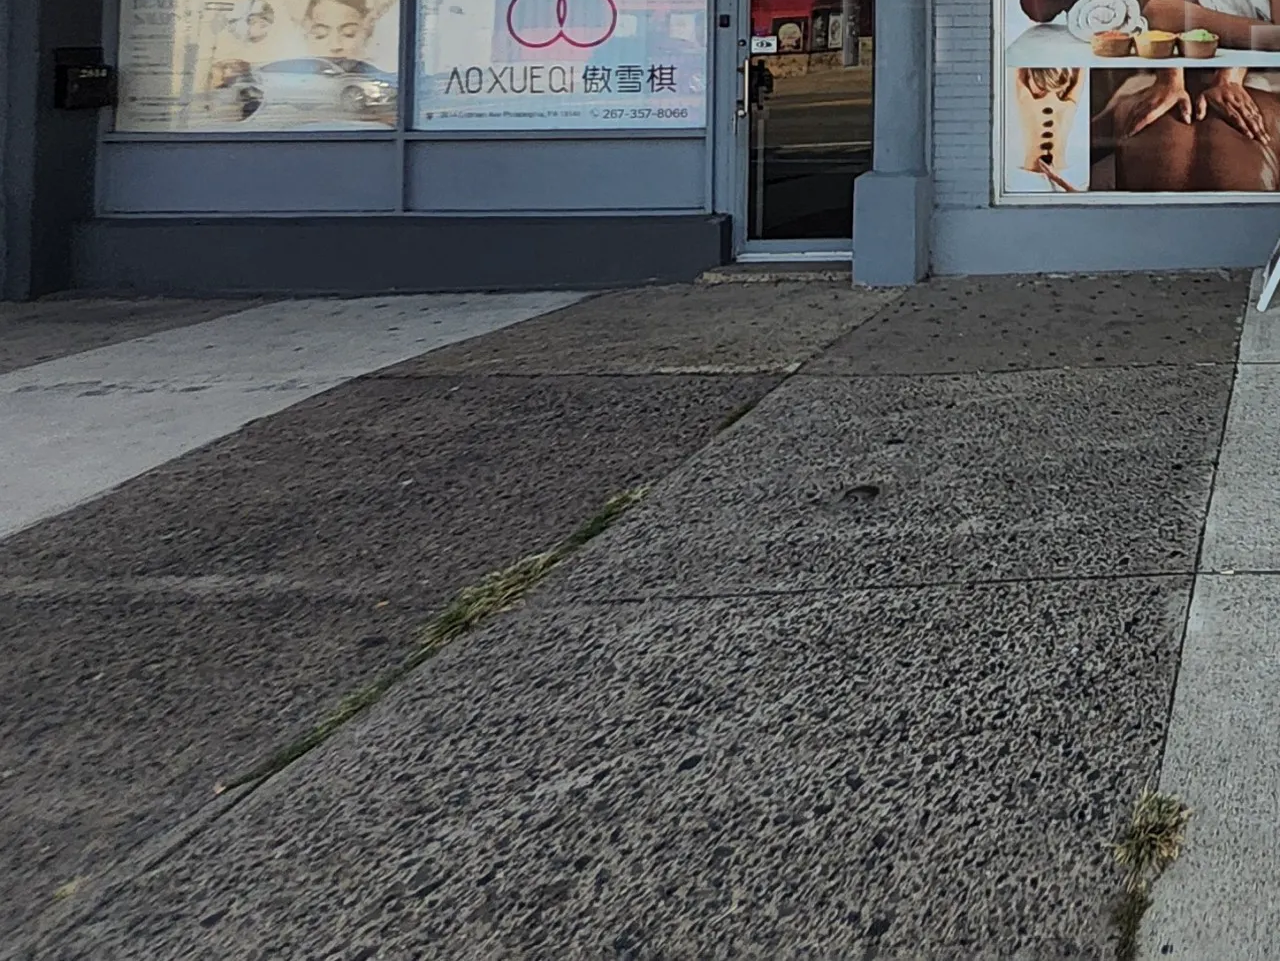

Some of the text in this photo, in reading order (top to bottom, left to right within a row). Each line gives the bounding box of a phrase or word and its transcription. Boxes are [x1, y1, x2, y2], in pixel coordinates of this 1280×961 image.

[581, 64, 678, 94] 傲雪棋
[602, 108, 689, 120] 267-357-8066
